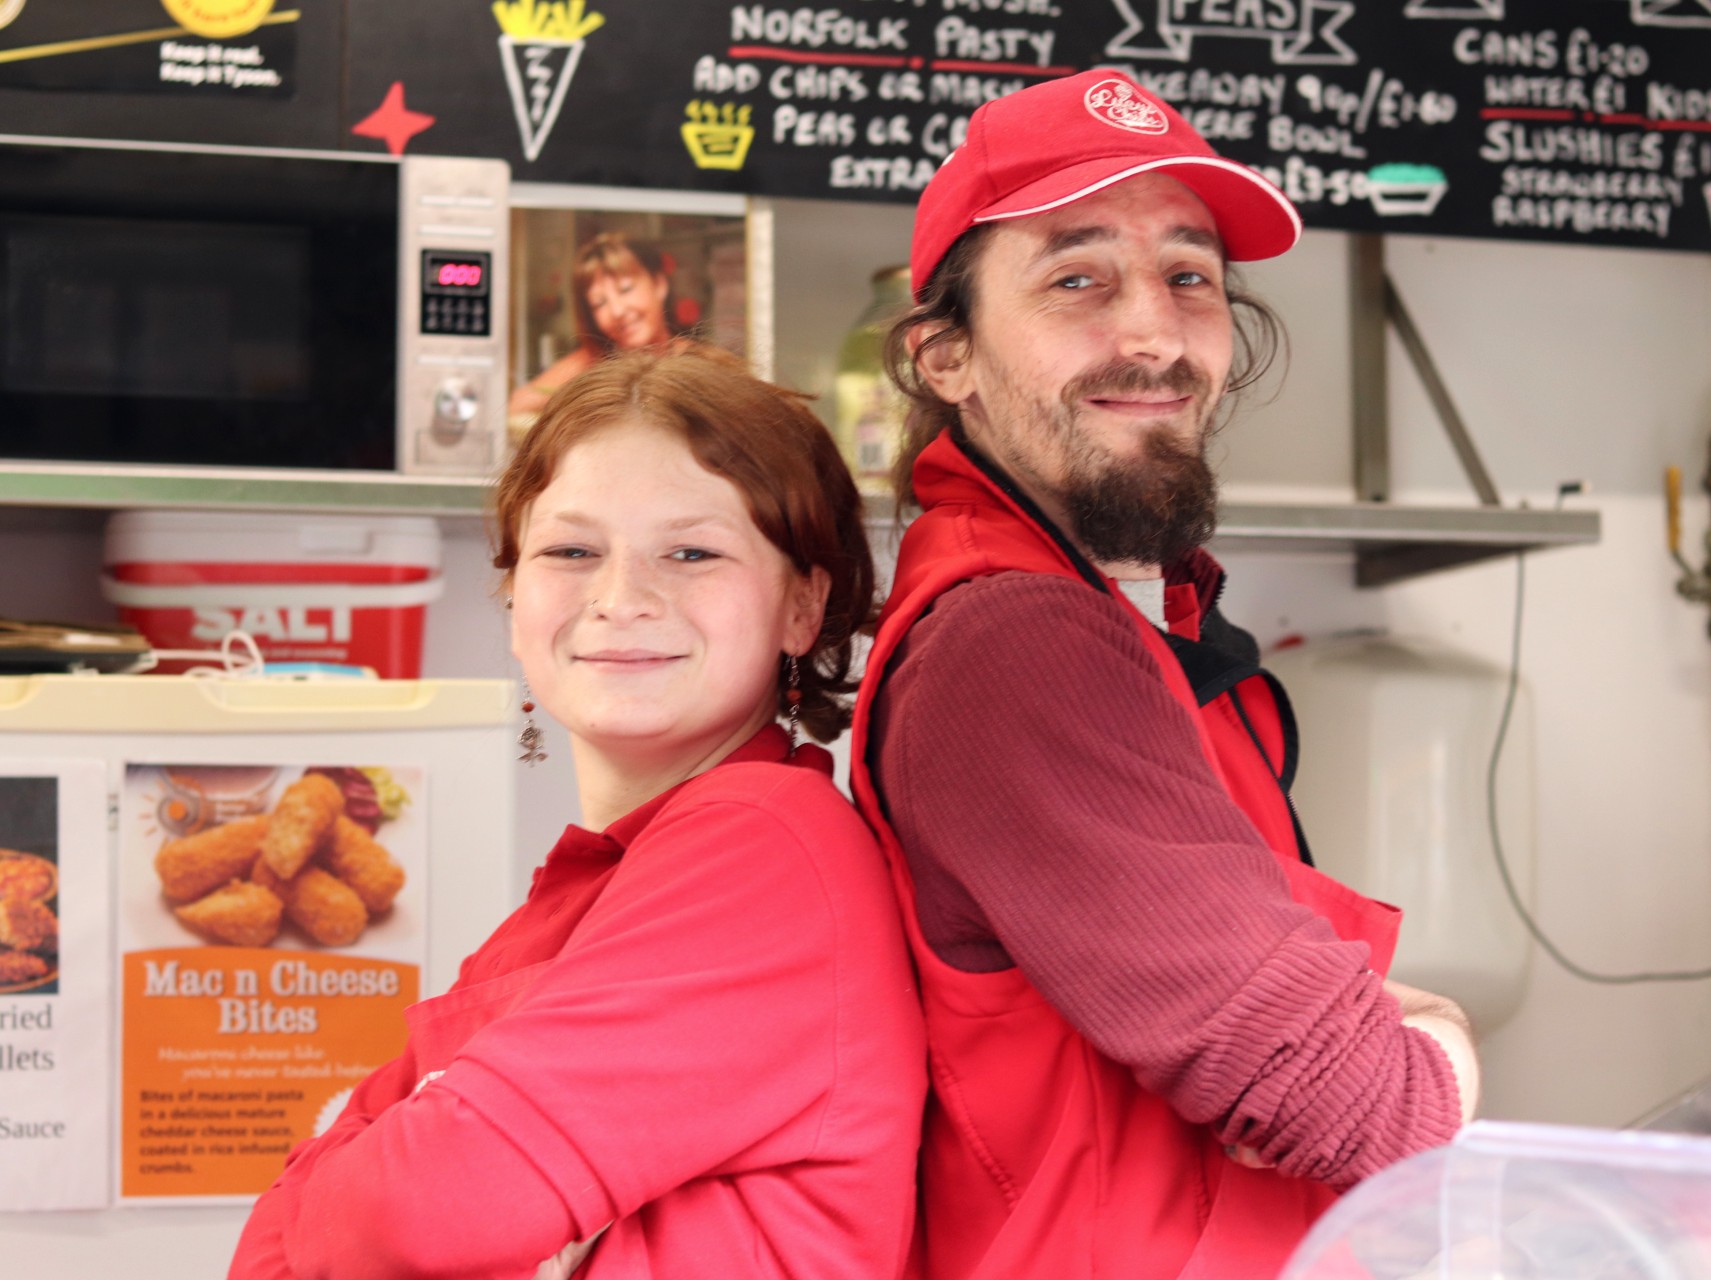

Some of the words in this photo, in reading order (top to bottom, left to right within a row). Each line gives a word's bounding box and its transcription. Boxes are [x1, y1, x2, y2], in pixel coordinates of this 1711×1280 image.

[160, 41, 206, 66] Keep
[206, 43, 222, 62] it
[223, 45, 264, 66] real.
[731, 5, 909, 49] NORFOLK
[935, 15, 1055, 67] PASTY
[1453, 27, 1559, 70] CANS
[160, 62, 206, 87] Keep
[206, 64, 222, 84] it
[223, 64, 282, 89] Tyson.
[693, 55, 760, 93] ADD
[769, 65, 868, 101] CHIPS
[878, 73, 924, 102] OR
[1484, 74, 1590, 110] WATER
[773, 104, 857, 145] PEAS
[867, 115, 912, 145] OR
[1268, 115, 1367, 158] BOWL
[1479, 120, 1664, 170] SLUSHIES
[1501, 164, 1684, 207] STRAWBERRY
[1492, 195, 1672, 238] RASPBERRY
[190, 602, 352, 642] SALT
[143, 960, 224, 996] Mac
[235, 969, 258, 996] n
[270, 960, 399, 997] Cheese
[217, 998, 319, 1034] Bites
[170, 1108, 231, 1120] delicious
[236, 1109, 286, 1119] mature
[198, 1088, 262, 1101] macaroni
[266, 1089, 304, 1103] pasta
[0, 1117, 66, 1140] Sauce
[139, 1126, 196, 1138] cheddar
[201, 1125, 248, 1137] cheese
[139, 1144, 188, 1156] coated
